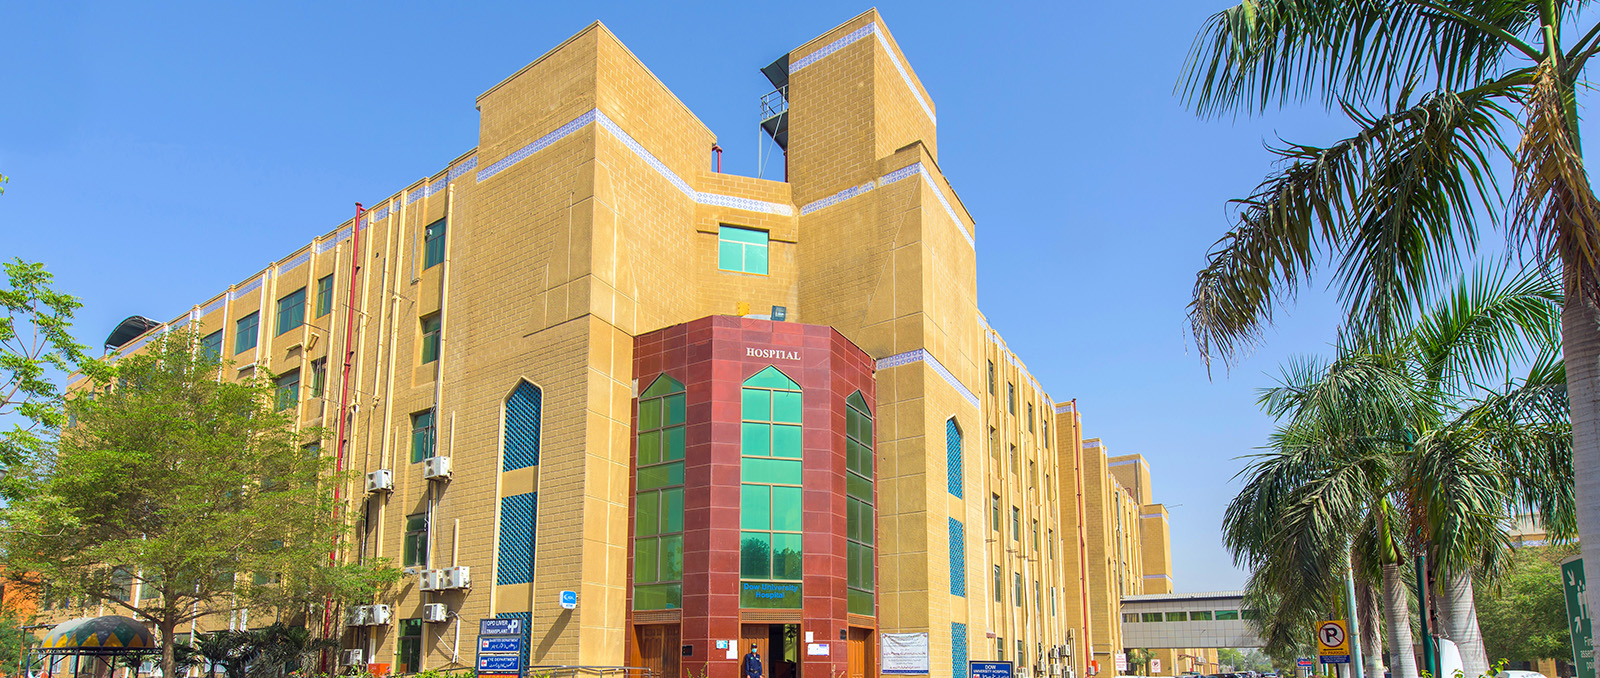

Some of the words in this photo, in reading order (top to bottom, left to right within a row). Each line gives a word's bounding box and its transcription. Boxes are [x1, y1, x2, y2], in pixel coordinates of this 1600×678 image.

[746, 347, 801, 360] HOSPITAL
[762, 584, 798, 592] University
[756, 592, 785, 600] Hospital
